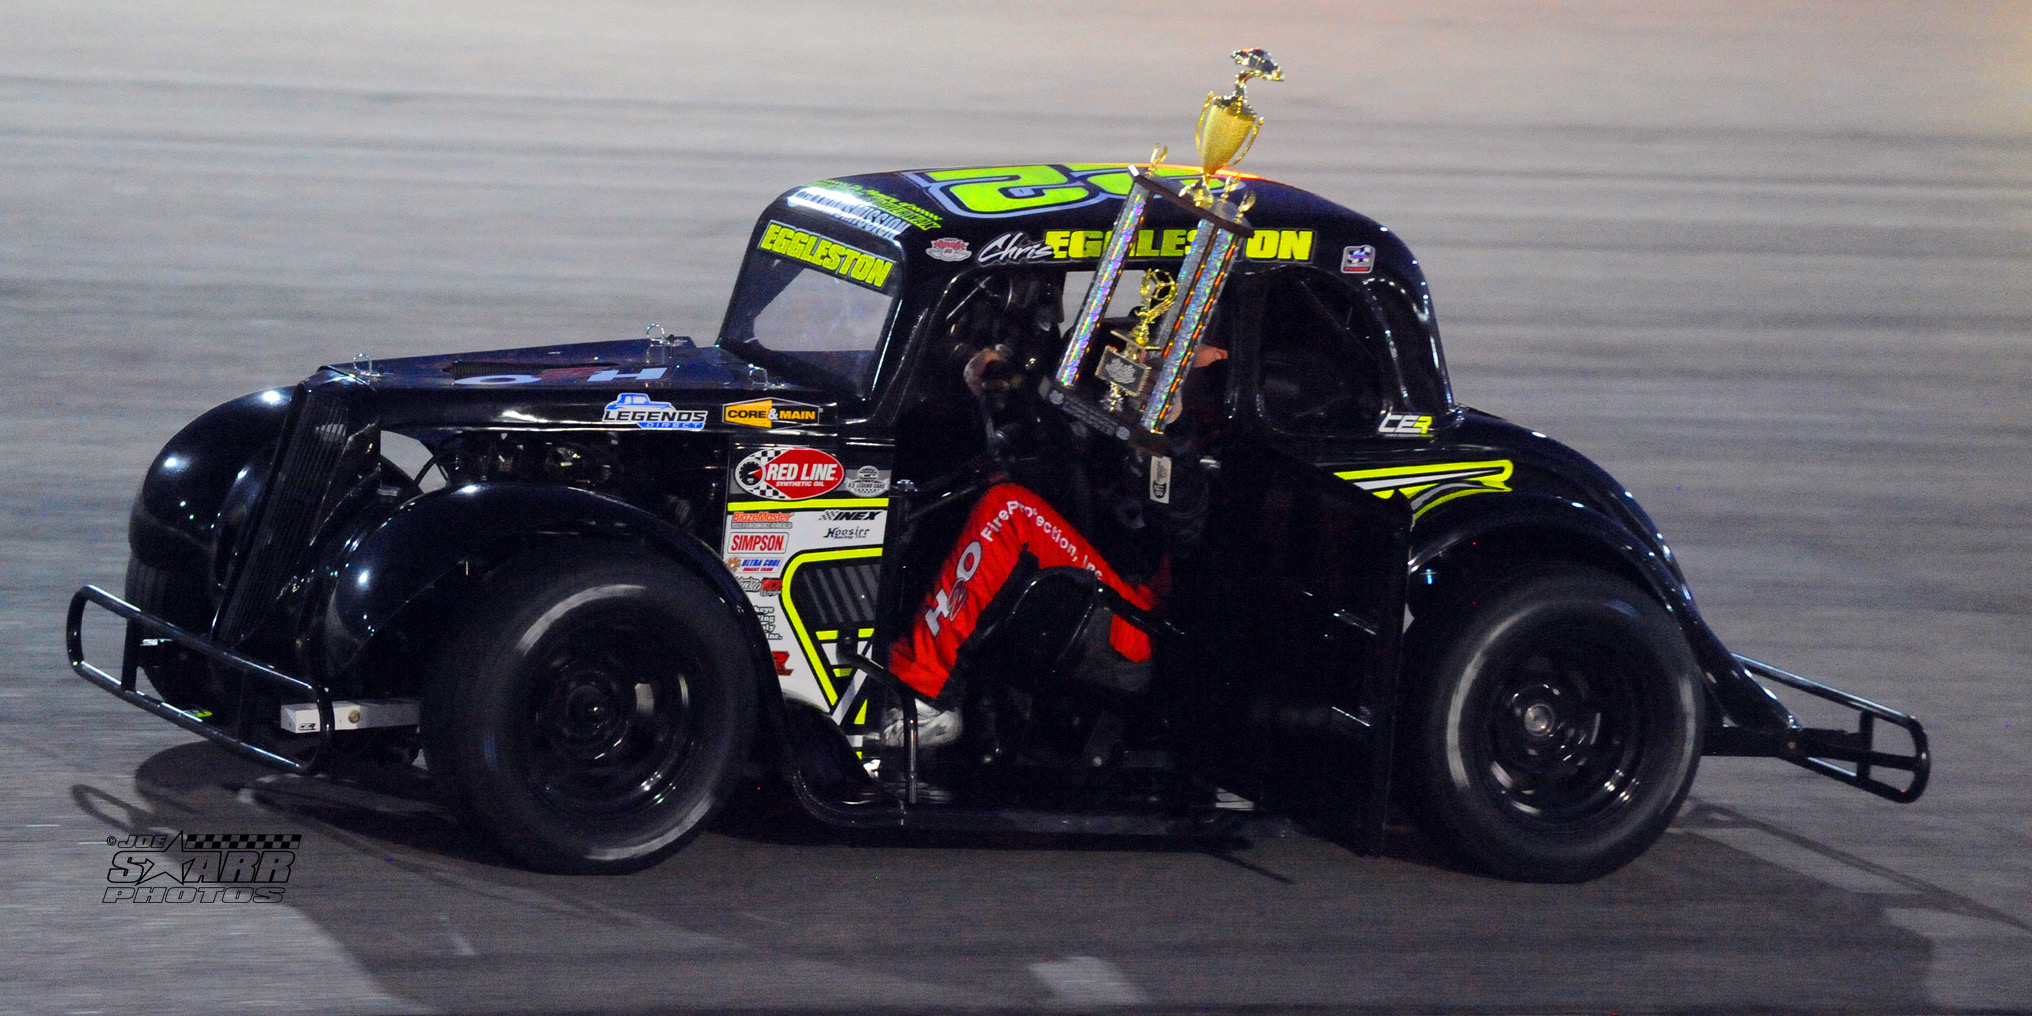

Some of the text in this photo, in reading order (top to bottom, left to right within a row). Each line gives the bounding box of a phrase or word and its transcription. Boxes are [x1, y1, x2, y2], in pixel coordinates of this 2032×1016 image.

[978, 232, 1055, 264] Chris
[1045, 229, 1313, 261] EGLEON
[760, 223, 893, 289] EGGLESTON
[605, 410, 707, 422] LEGENDS
[646, 422, 703, 430] DIRECT
[766, 463, 799, 481] RED
[801, 463, 838, 481] LINE
[732, 511, 791, 523] BlazeMaster
[832, 510, 883, 521] INEX
[731, 534, 785, 552] SIMPSON
